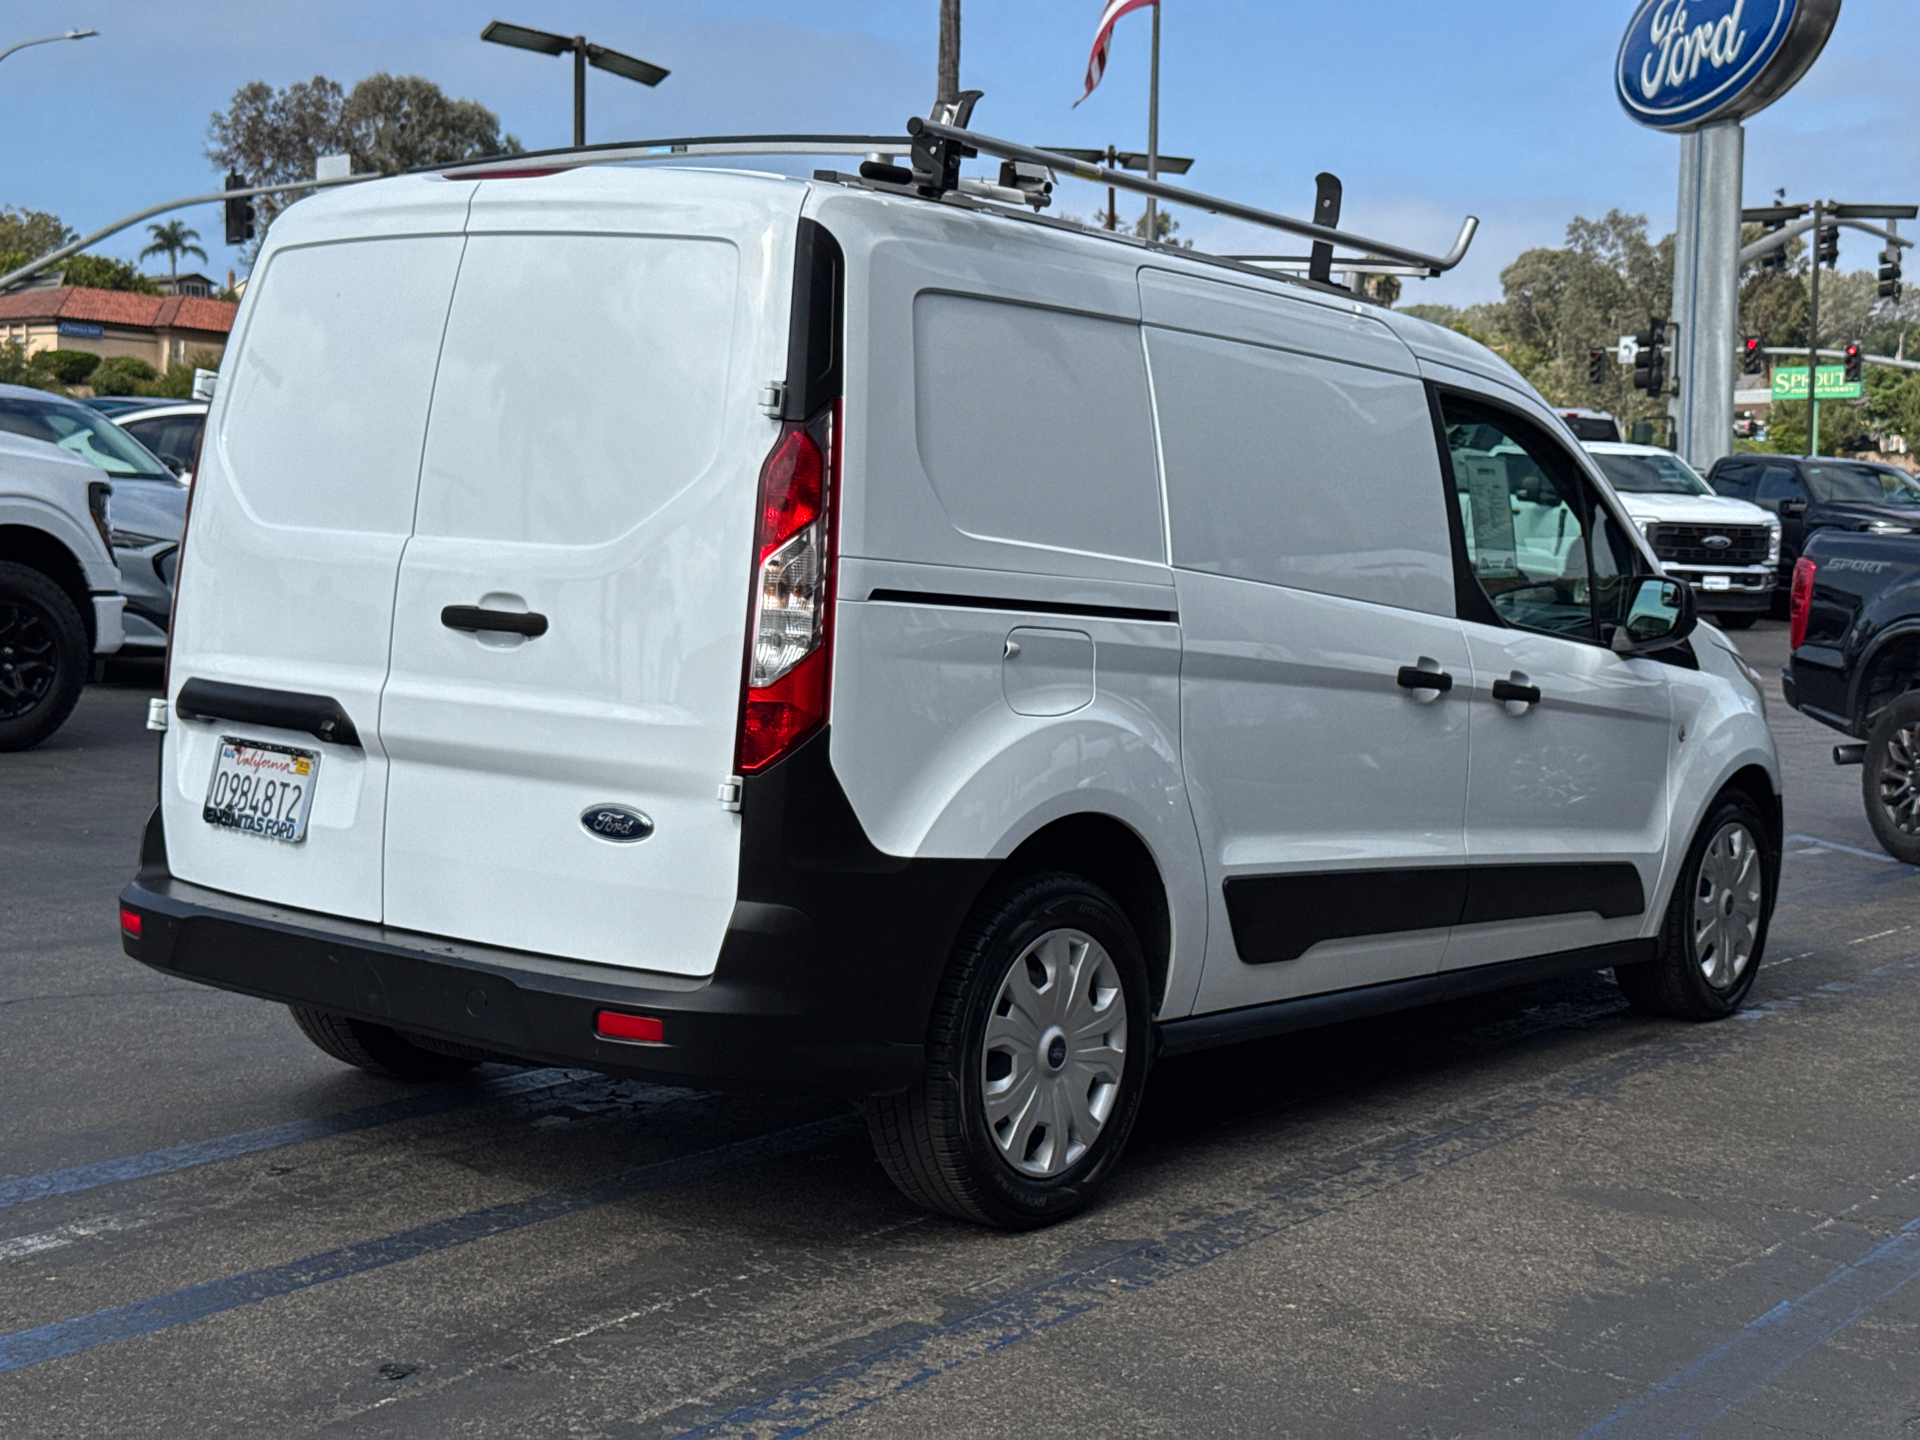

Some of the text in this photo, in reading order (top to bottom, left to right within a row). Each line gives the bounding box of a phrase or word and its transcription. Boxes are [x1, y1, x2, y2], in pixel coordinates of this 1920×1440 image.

[1641, 0, 1746, 99] Ford
[1775, 371, 1858, 394] SPROUT
[1821, 558, 1891, 573] SPORT
[236, 747, 297, 775] California
[213, 771, 303, 824] 09848T2
[264, 818, 295, 839] FORD
[595, 811, 633, 835] Ford
